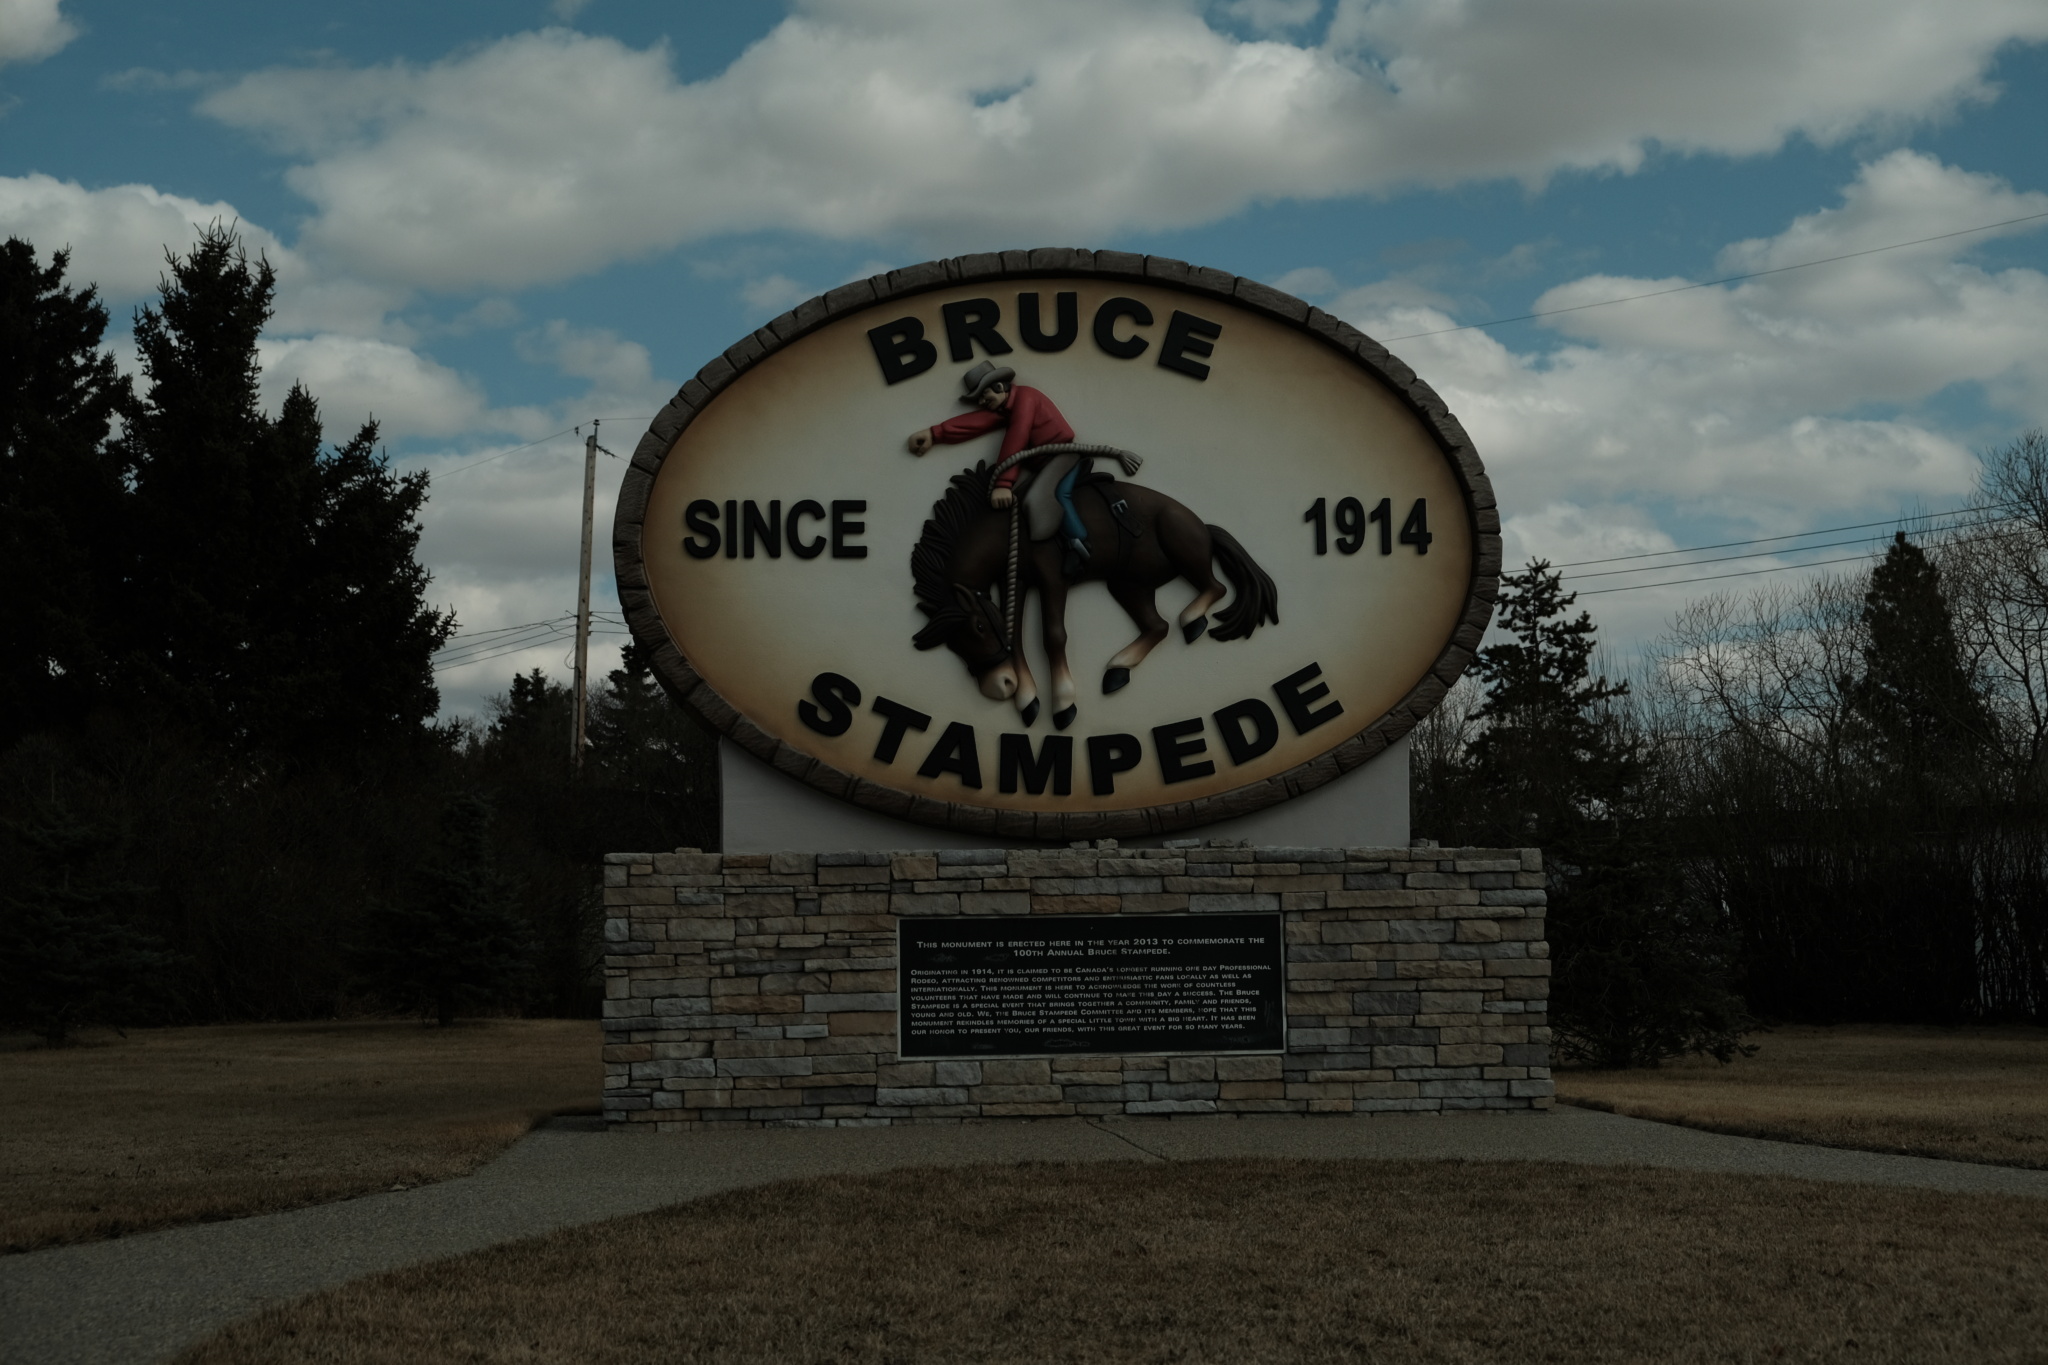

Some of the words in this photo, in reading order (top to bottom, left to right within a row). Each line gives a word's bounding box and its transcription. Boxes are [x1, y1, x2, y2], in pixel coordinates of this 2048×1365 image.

[867, 291, 1223, 385] BRUCE
[684, 499, 868, 558] SINCE
[1305, 496, 1433, 555] 1914
[799, 661, 1345, 796] STAMPEDE
[1013, 949, 1043, 957] 100TH
[1121, 947, 1171, 955] STAMPEDE.
